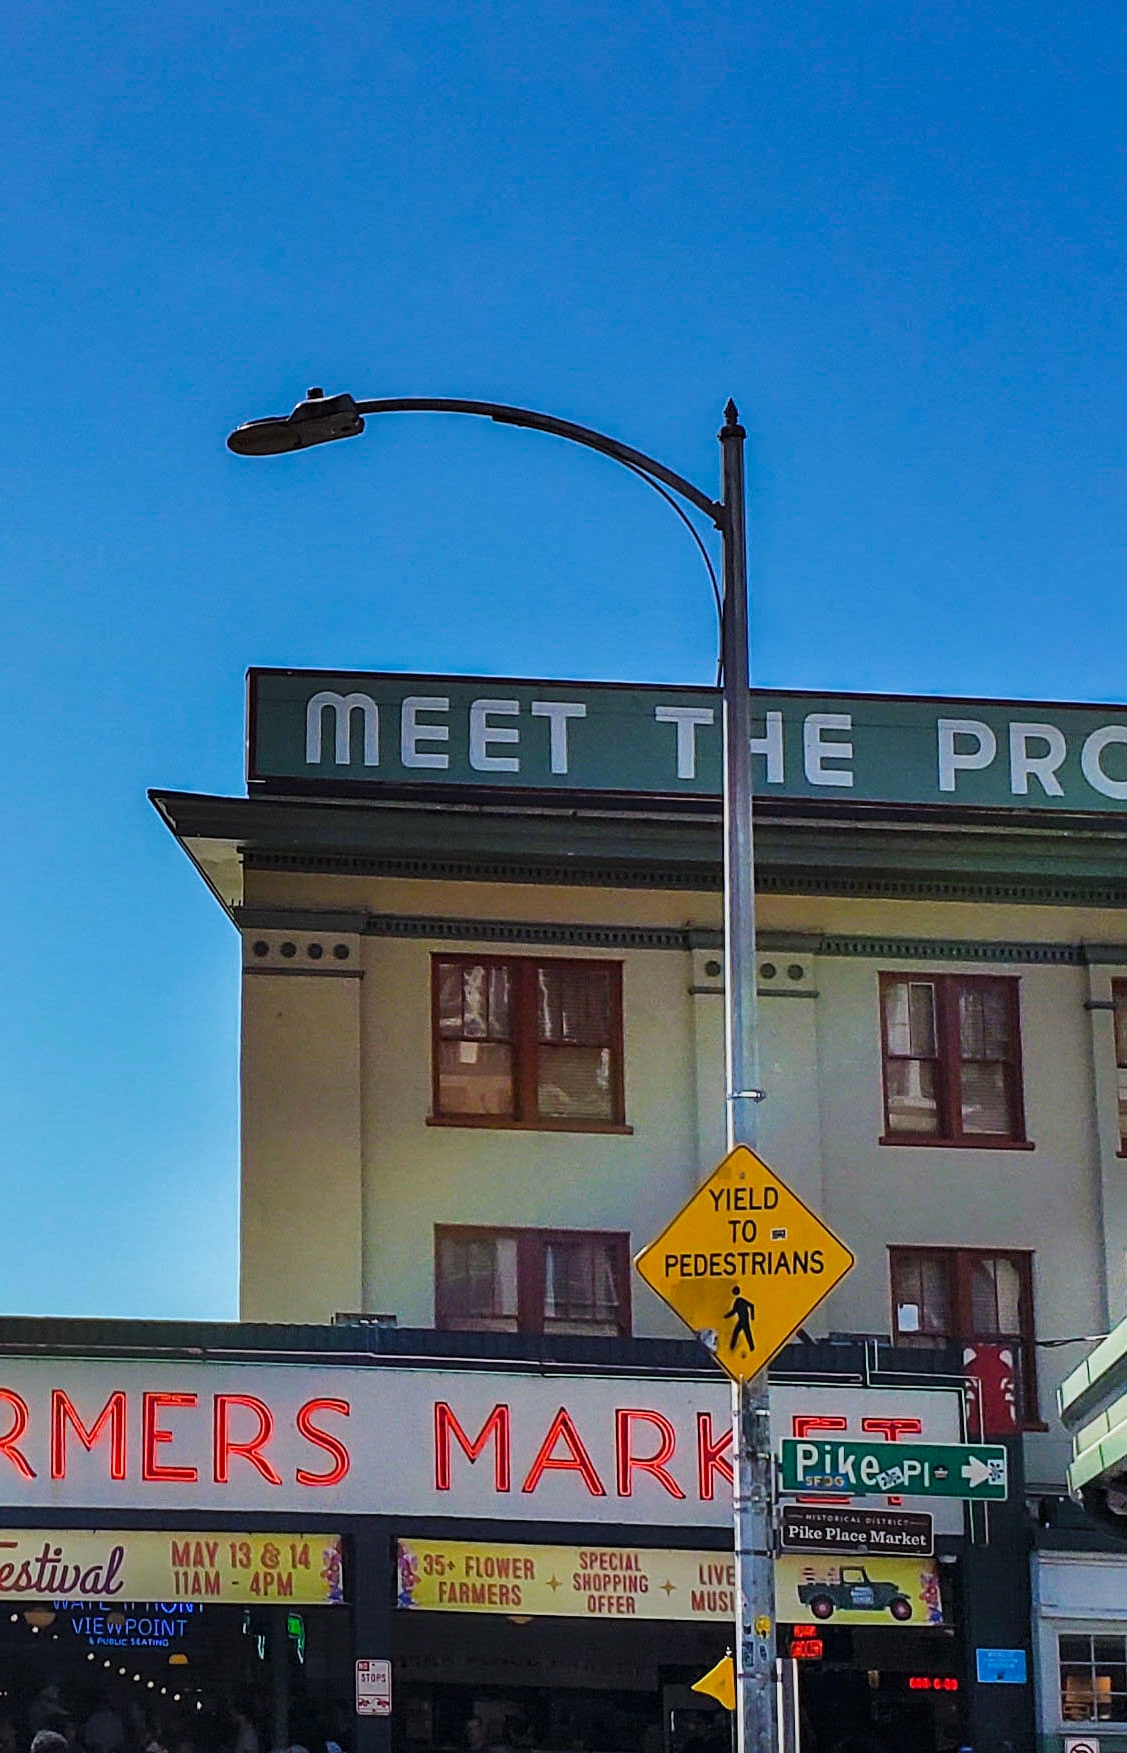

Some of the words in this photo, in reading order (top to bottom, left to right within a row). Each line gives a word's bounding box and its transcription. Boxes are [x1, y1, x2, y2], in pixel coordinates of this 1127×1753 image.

[305, 691, 588, 775] MEET
[655, 706, 854, 787] THE
[709, 1187, 778, 1211] YIELD
[728, 1220, 757, 1243] TO
[665, 1250, 824, 1277] PEDESTRIANS
[796, 1443, 880, 1486] Pike
[903, 1459, 930, 1487] Pl
[805, 1513, 861, 1524] HISTORICAL
[865, 1516, 909, 1526] DISTRICT
[788, 1525, 823, 1540] Pike
[825, 1527, 867, 1542] Place
[869, 1530, 927, 1546] Market
[172, 1541, 219, 1568] MAY
[229, 1542, 252, 1569] 13
[260, 1542, 281, 1569] &
[289, 1543, 311, 1569] 14
[579, 1551, 642, 1572] SPECIAL
[423, 1554, 455, 1577] 35+
[465, 1556, 535, 1580] FLOWER
[699, 1564, 735, 1586] LIVE
[174, 1571, 221, 1596] 11AM
[249, 1571, 293, 1596] 4PM
[438, 1581, 522, 1606] FARMERS
[572, 1573, 649, 1593] SHOPPING
[587, 1594, 636, 1614] OFFER
[691, 1590, 735, 1612] MUSI
[72, 1617, 188, 1637] VIEWPOINT
[97, 1637, 127, 1646] PUBLIC
[130, 1638, 170, 1647] SEATING
[361, 1673, 386, 1682] STOPS
